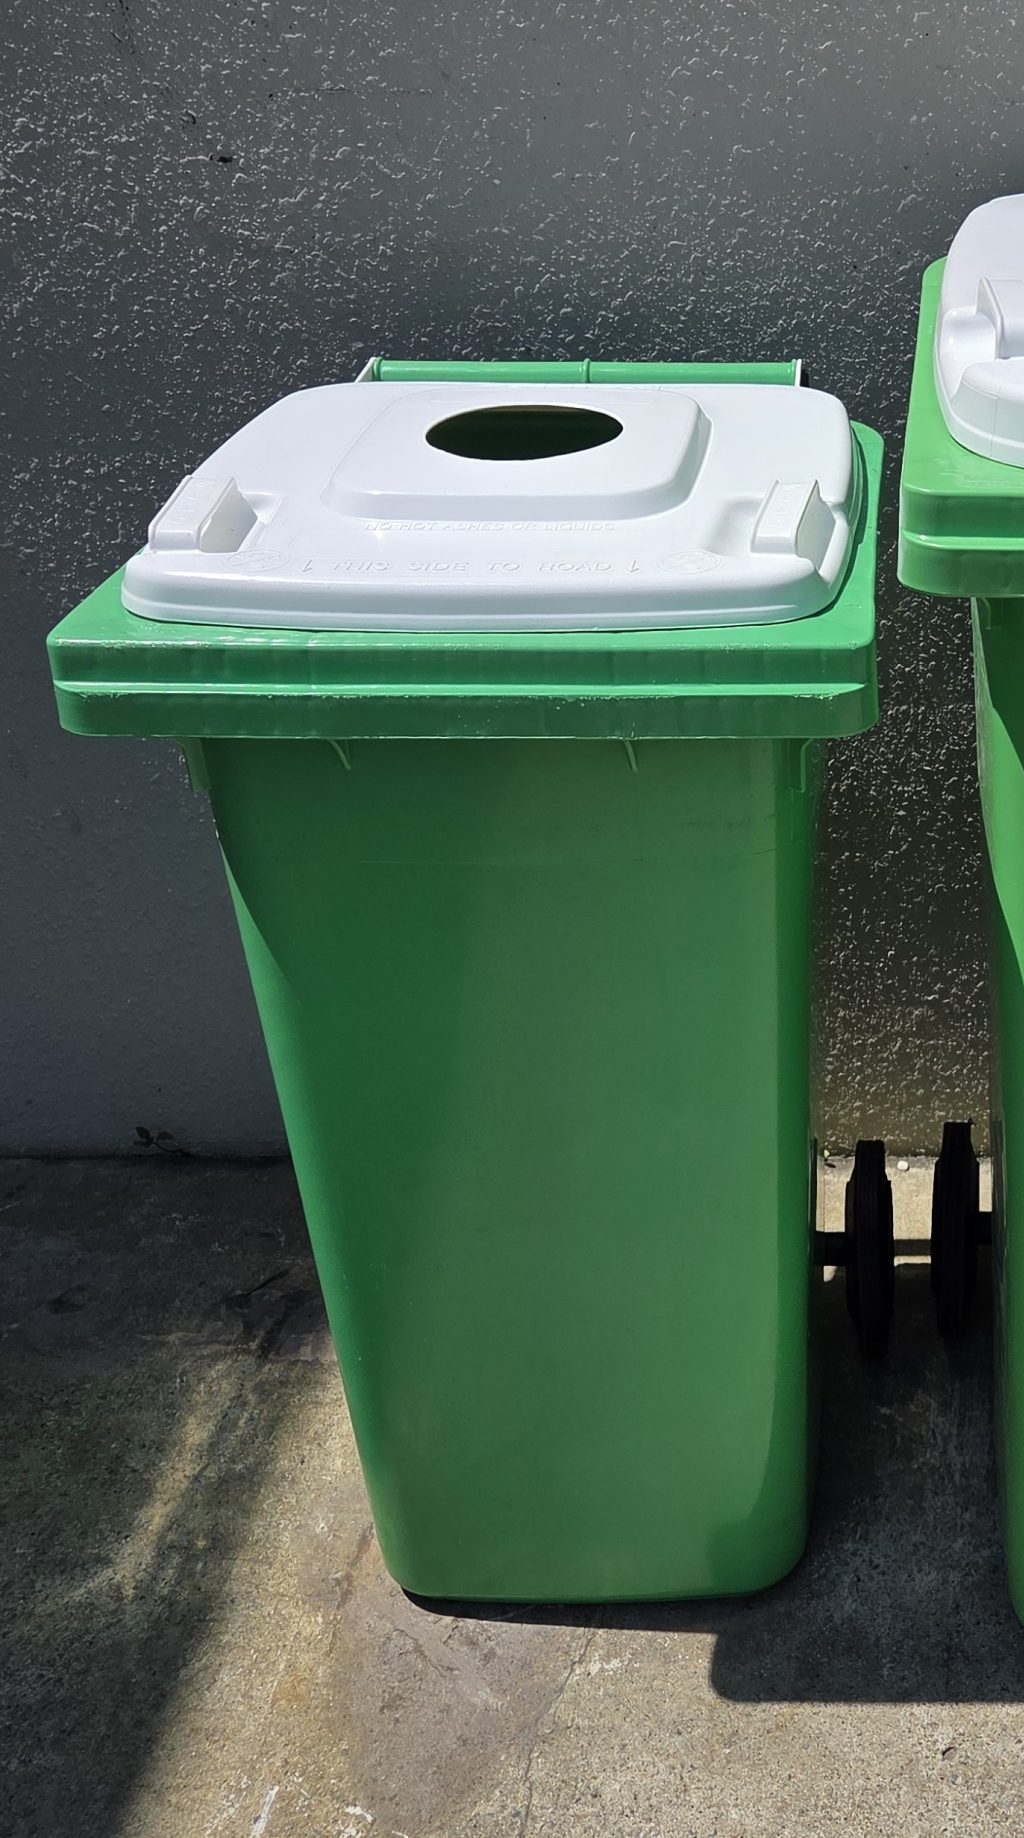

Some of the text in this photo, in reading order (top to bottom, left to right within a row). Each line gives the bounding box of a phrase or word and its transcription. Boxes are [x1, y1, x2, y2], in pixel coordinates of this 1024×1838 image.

[329, 559, 612, 573] THIS SIDE TO ROAD
